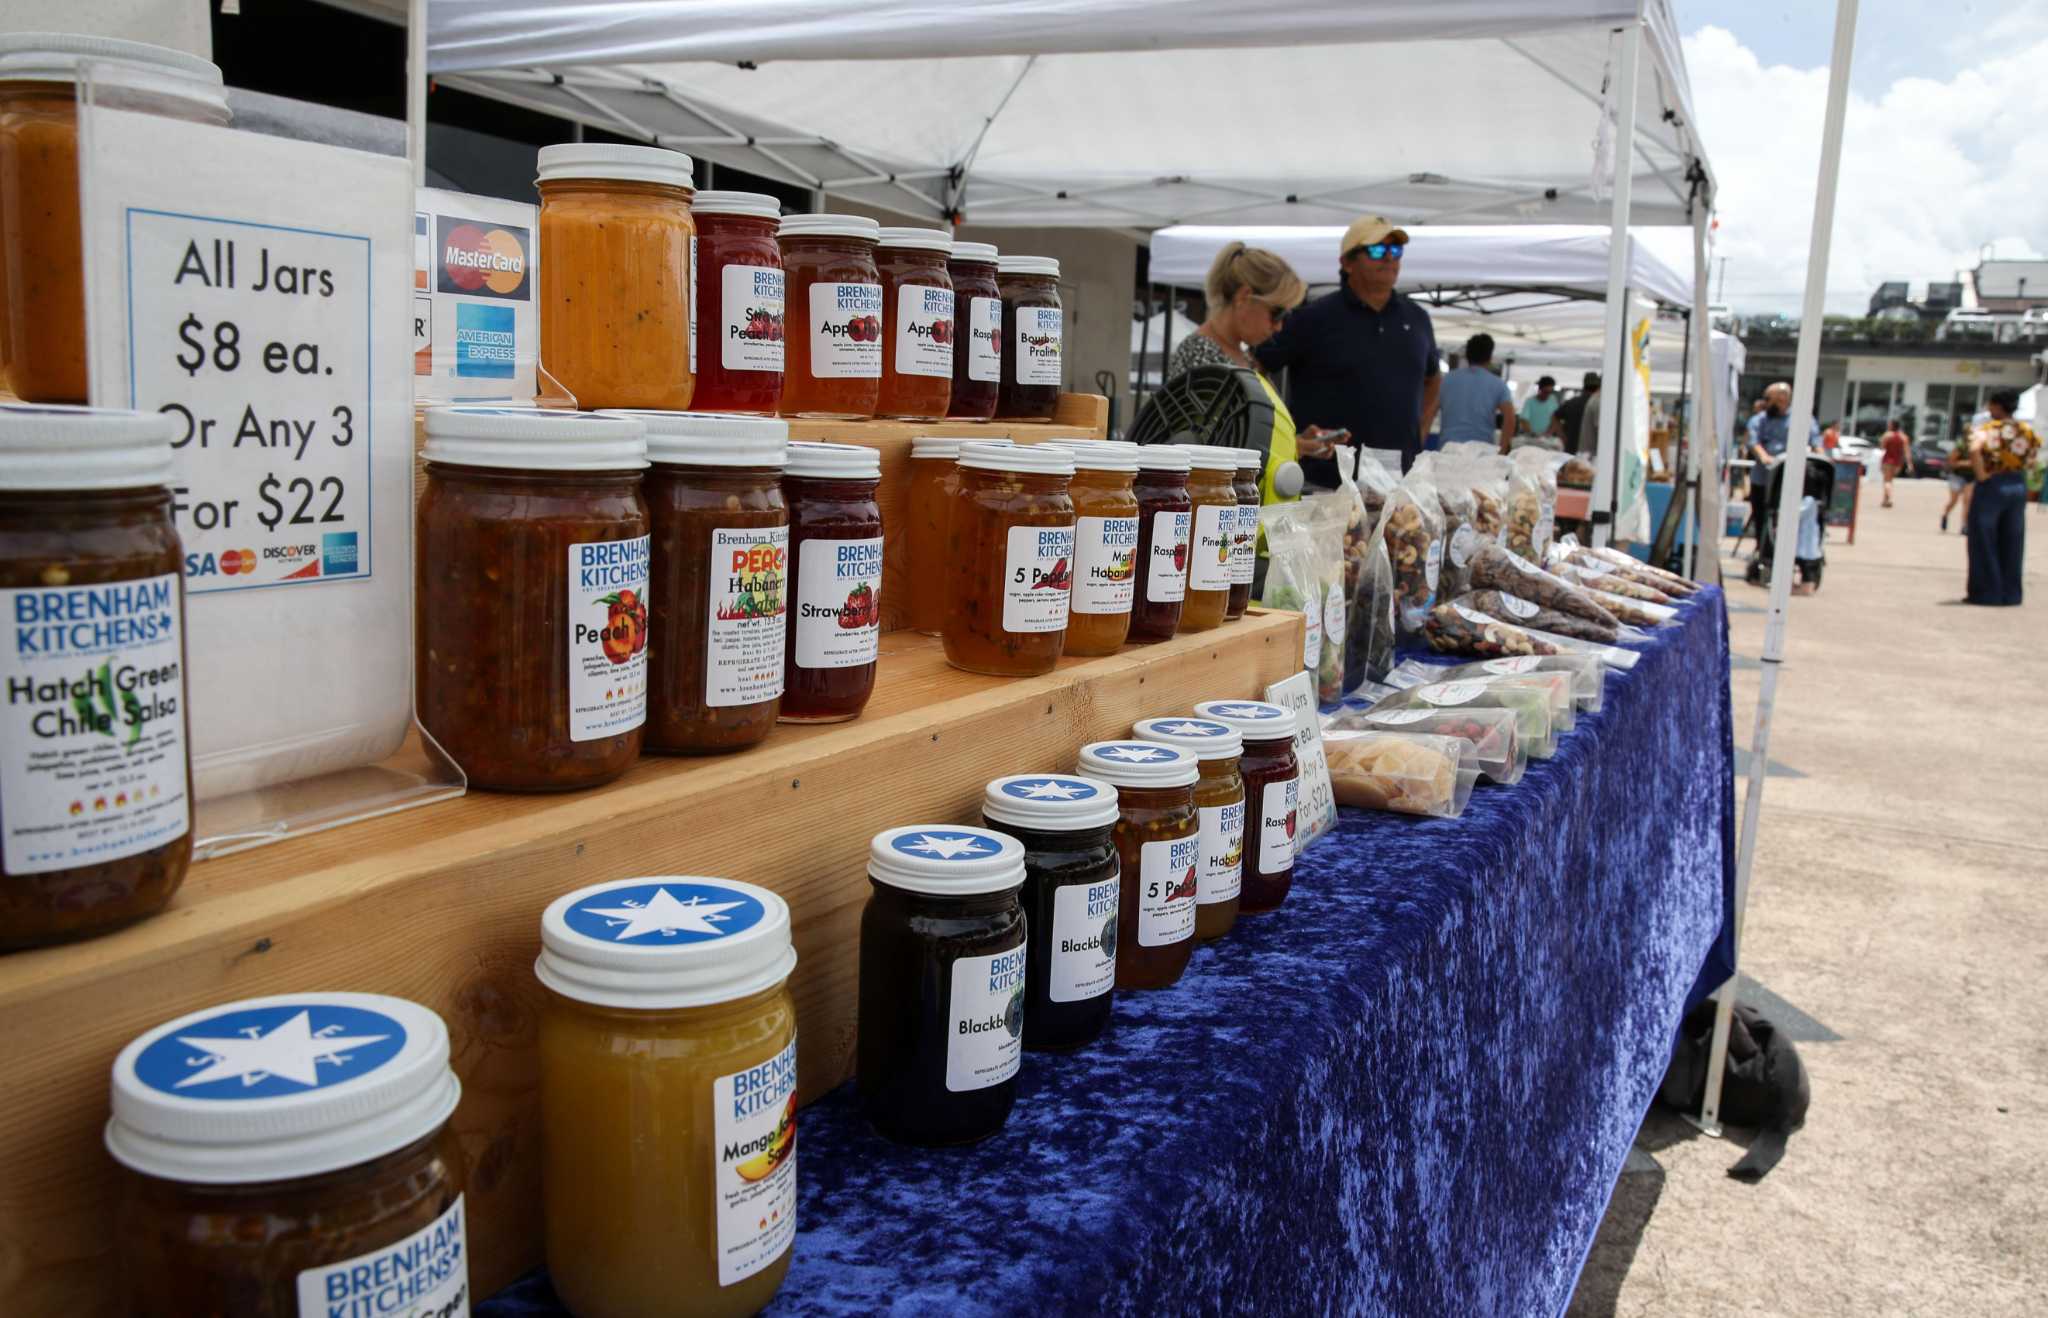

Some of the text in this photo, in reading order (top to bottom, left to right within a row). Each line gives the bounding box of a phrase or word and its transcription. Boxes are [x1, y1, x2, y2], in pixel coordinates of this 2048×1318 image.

[174, 239, 334, 297] All Jars
[446, 246, 522, 273] MasterCard
[753, 285, 785, 298] KITCHEN
[754, 271, 785, 286] BRENH
[177, 313, 334, 376] $8 ea.
[457, 329, 512, 346] AMERICAN
[468, 345, 515, 359] EXPRESS
[158, 403, 353, 461] Or Any 3
[170, 473, 345, 532] For $22
[263, 544, 316, 559] DISCOVER
[717, 533, 766, 544] Brenham
[185, 552, 217, 577] SA
[1014, 567, 1026, 583] 5
[15, 578, 171, 625] BRENHAM
[16, 612, 158, 653] KITCHENS
[576, 616, 629, 645] Peach
[8, 661, 179, 705] Hatch Green
[32, 695, 177, 738] Chile Salsa
[1147, 882, 1159, 898] 5
[1062, 936, 1101, 952] Blackb
[959, 1013, 1006, 1035] Blackb
[723, 1131, 776, 1163] Mango
[326, 1209, 459, 1302] BRENHAM
